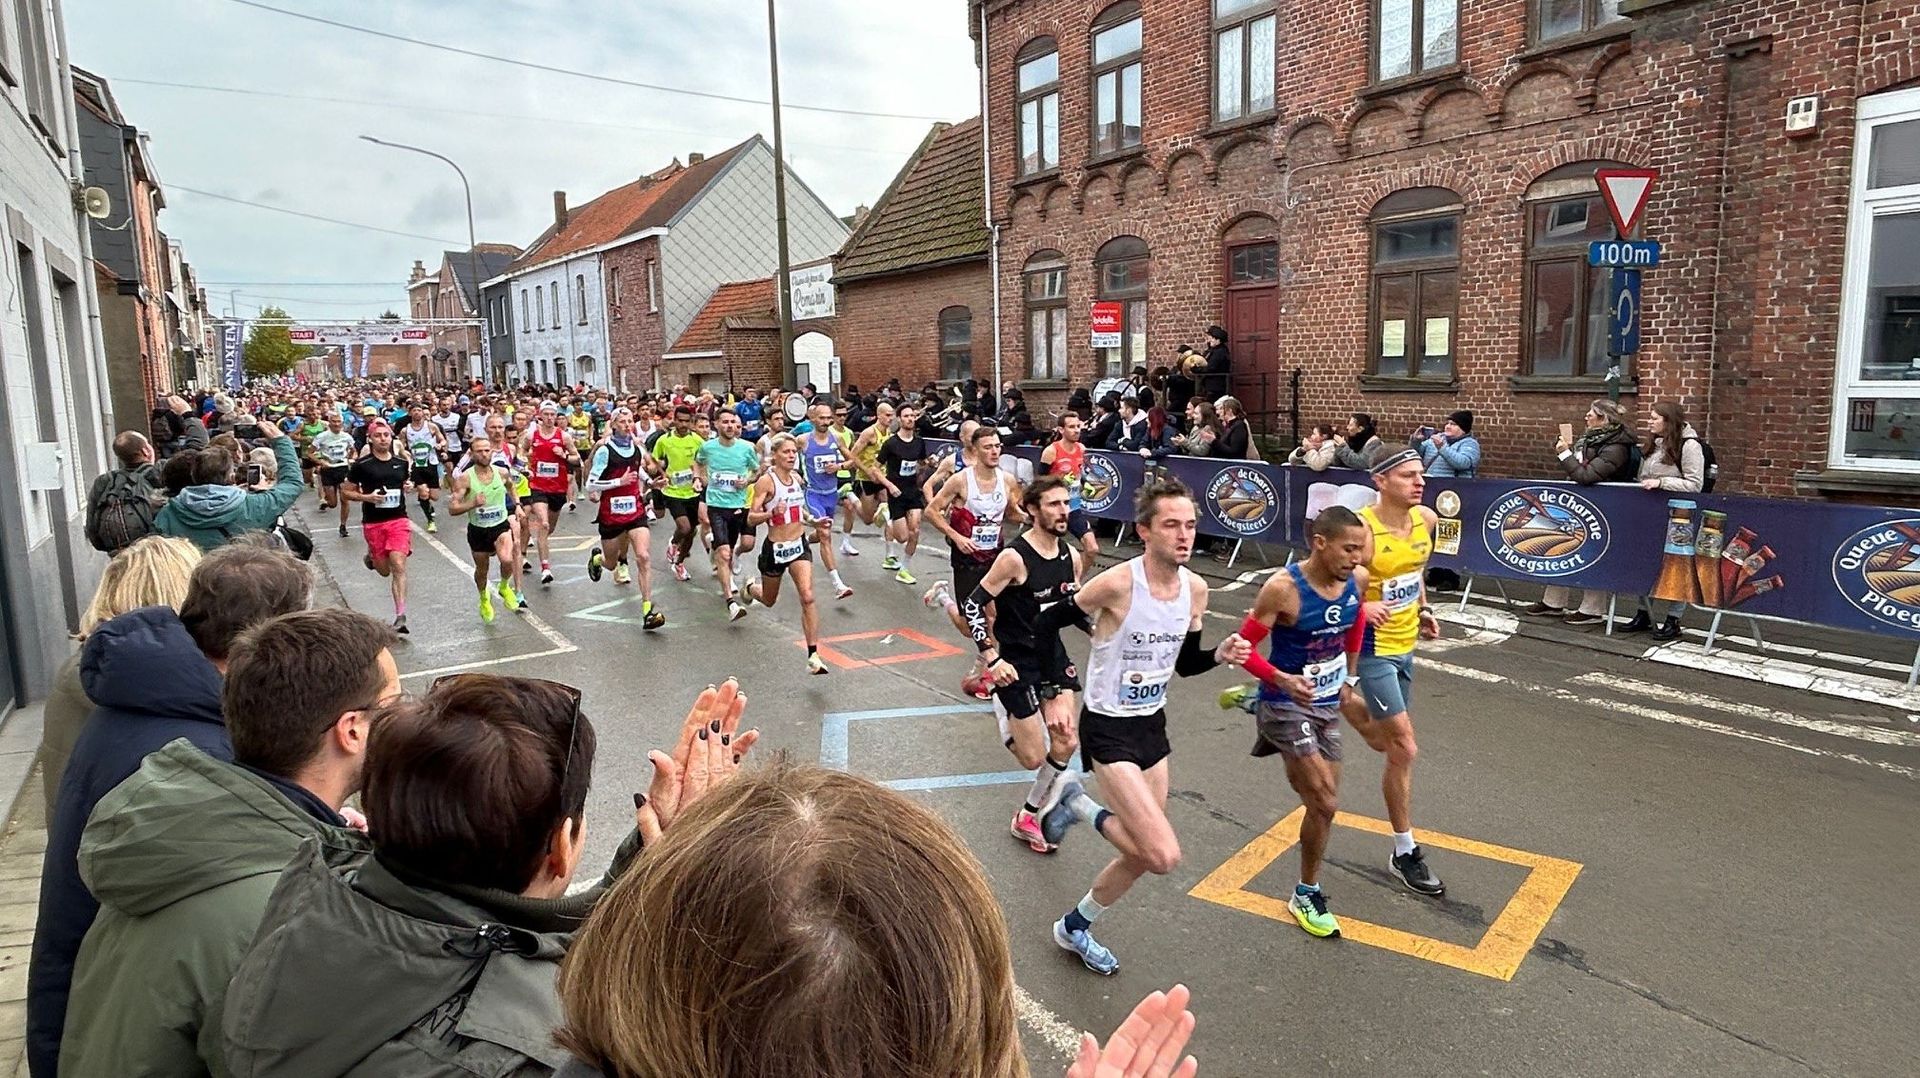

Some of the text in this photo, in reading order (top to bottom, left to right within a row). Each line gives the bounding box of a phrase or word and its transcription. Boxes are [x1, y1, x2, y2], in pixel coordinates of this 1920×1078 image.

[1599, 243, 1651, 264] 100m
[225, 320, 237, 391] ANUXEEM
[1208, 469, 1275, 506] Queue de Charrue
[479, 511, 501, 519] 3024
[613, 502, 633, 510] 3011
[1487, 490, 1602, 541] Queue de Charrue
[1219, 511, 1267, 532] Ploegsteert
[1438, 526, 1459, 539] BEER
[1497, 544, 1585, 573] Ploegsteert
[1840, 529, 1898, 570] Queue
